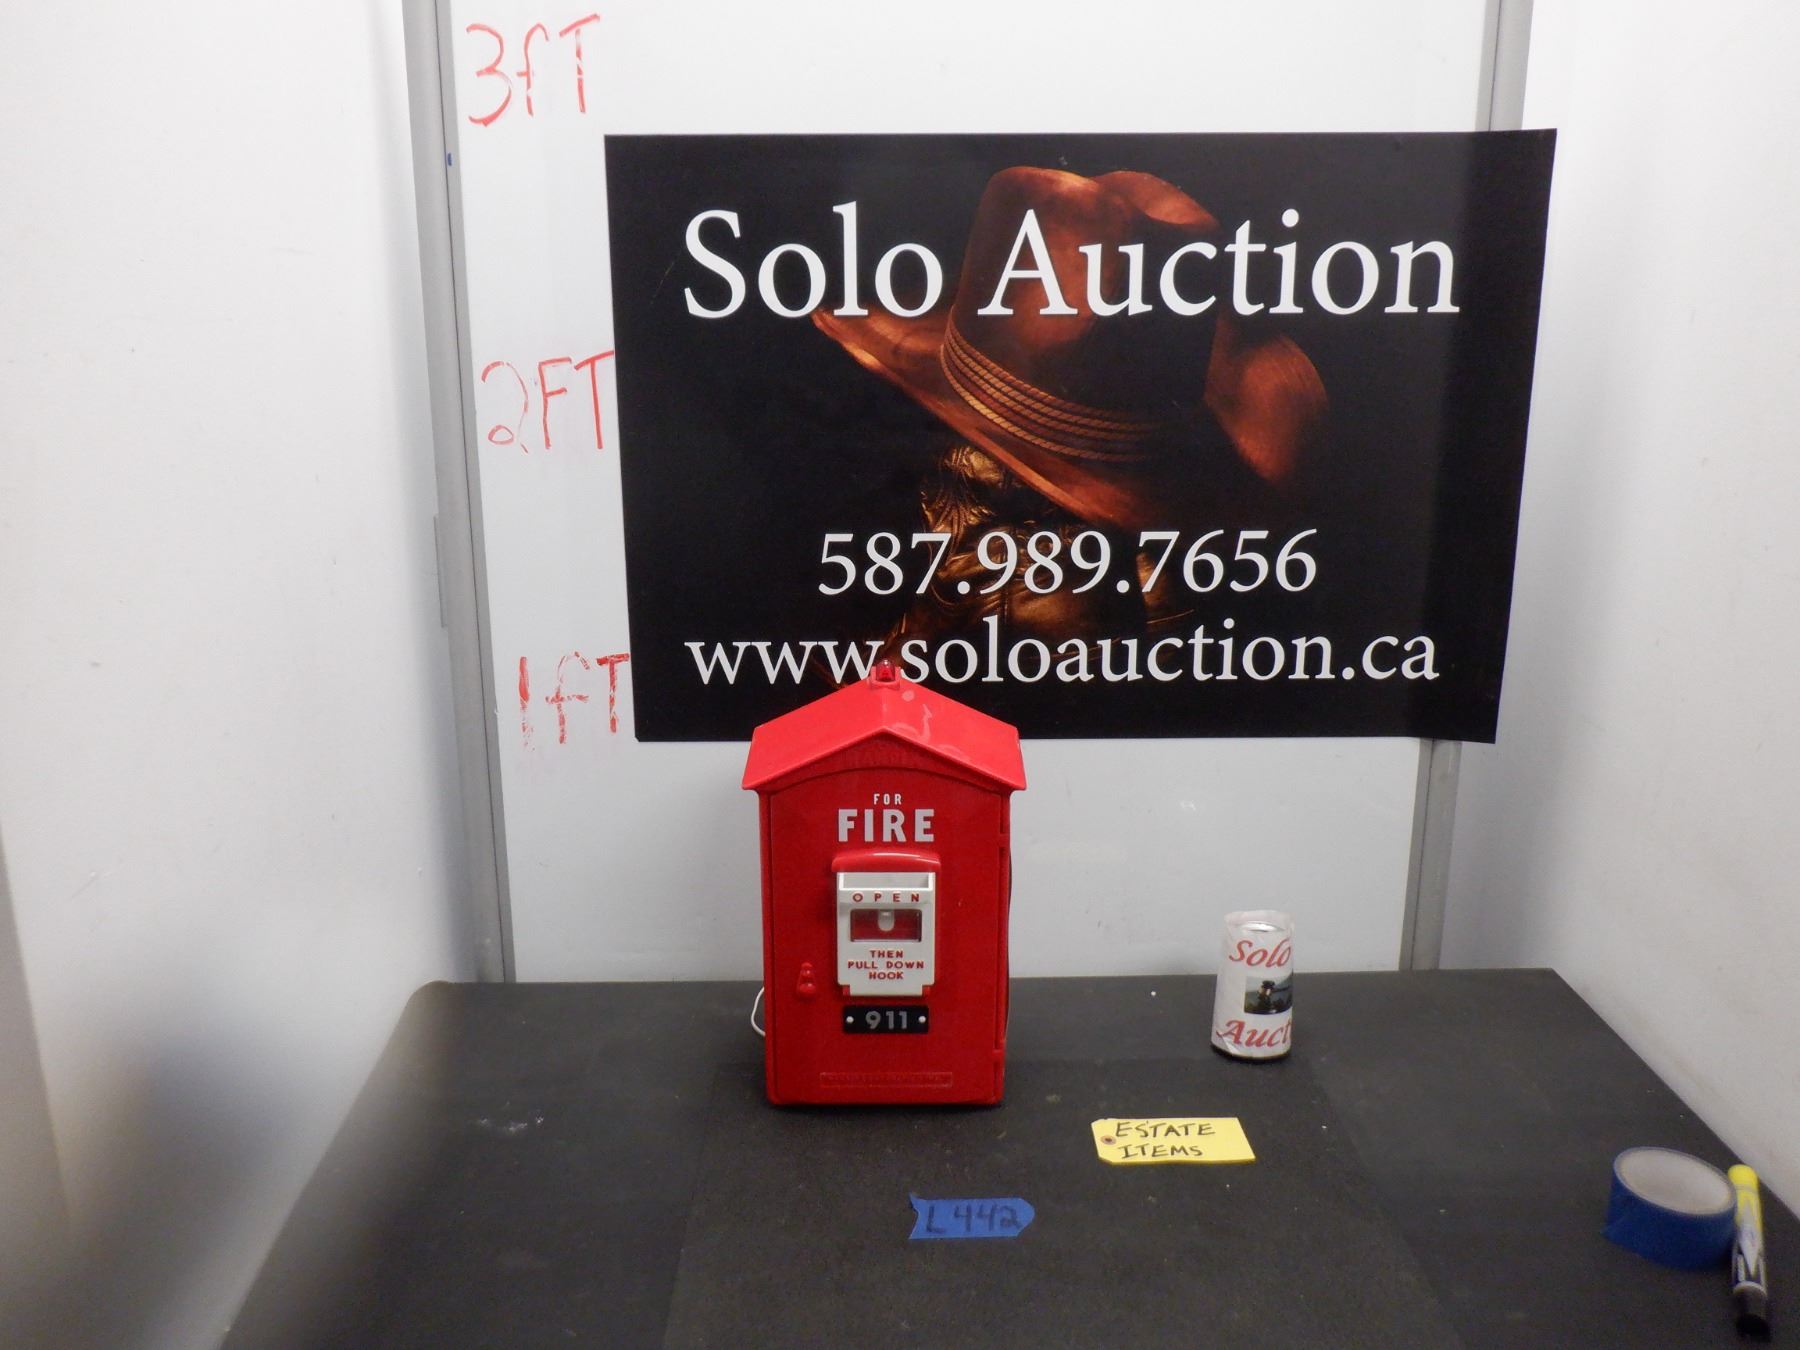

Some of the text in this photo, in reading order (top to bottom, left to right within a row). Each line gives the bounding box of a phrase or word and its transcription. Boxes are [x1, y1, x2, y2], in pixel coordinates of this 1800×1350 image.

[684, 201, 1460, 319] Solo Auction
[818, 528, 1317, 595] 587.989.7656
[684, 615, 1440, 685] wwwsoloauction.ca
[873, 793, 902, 806] FOR
[838, 808, 935, 842] FIRE
[852, 893, 920, 903] OPEN
[870, 950, 904, 959] THEN
[1229, 938, 1292, 968] Solo
[847, 961, 924, 969] PULL DOWN
[868, 971, 904, 980] HOOK
[865, 1010, 908, 1030] 911
[1115, 1121, 1216, 1138] ESTATE
[1117, 1144, 1204, 1159] ITEMS
